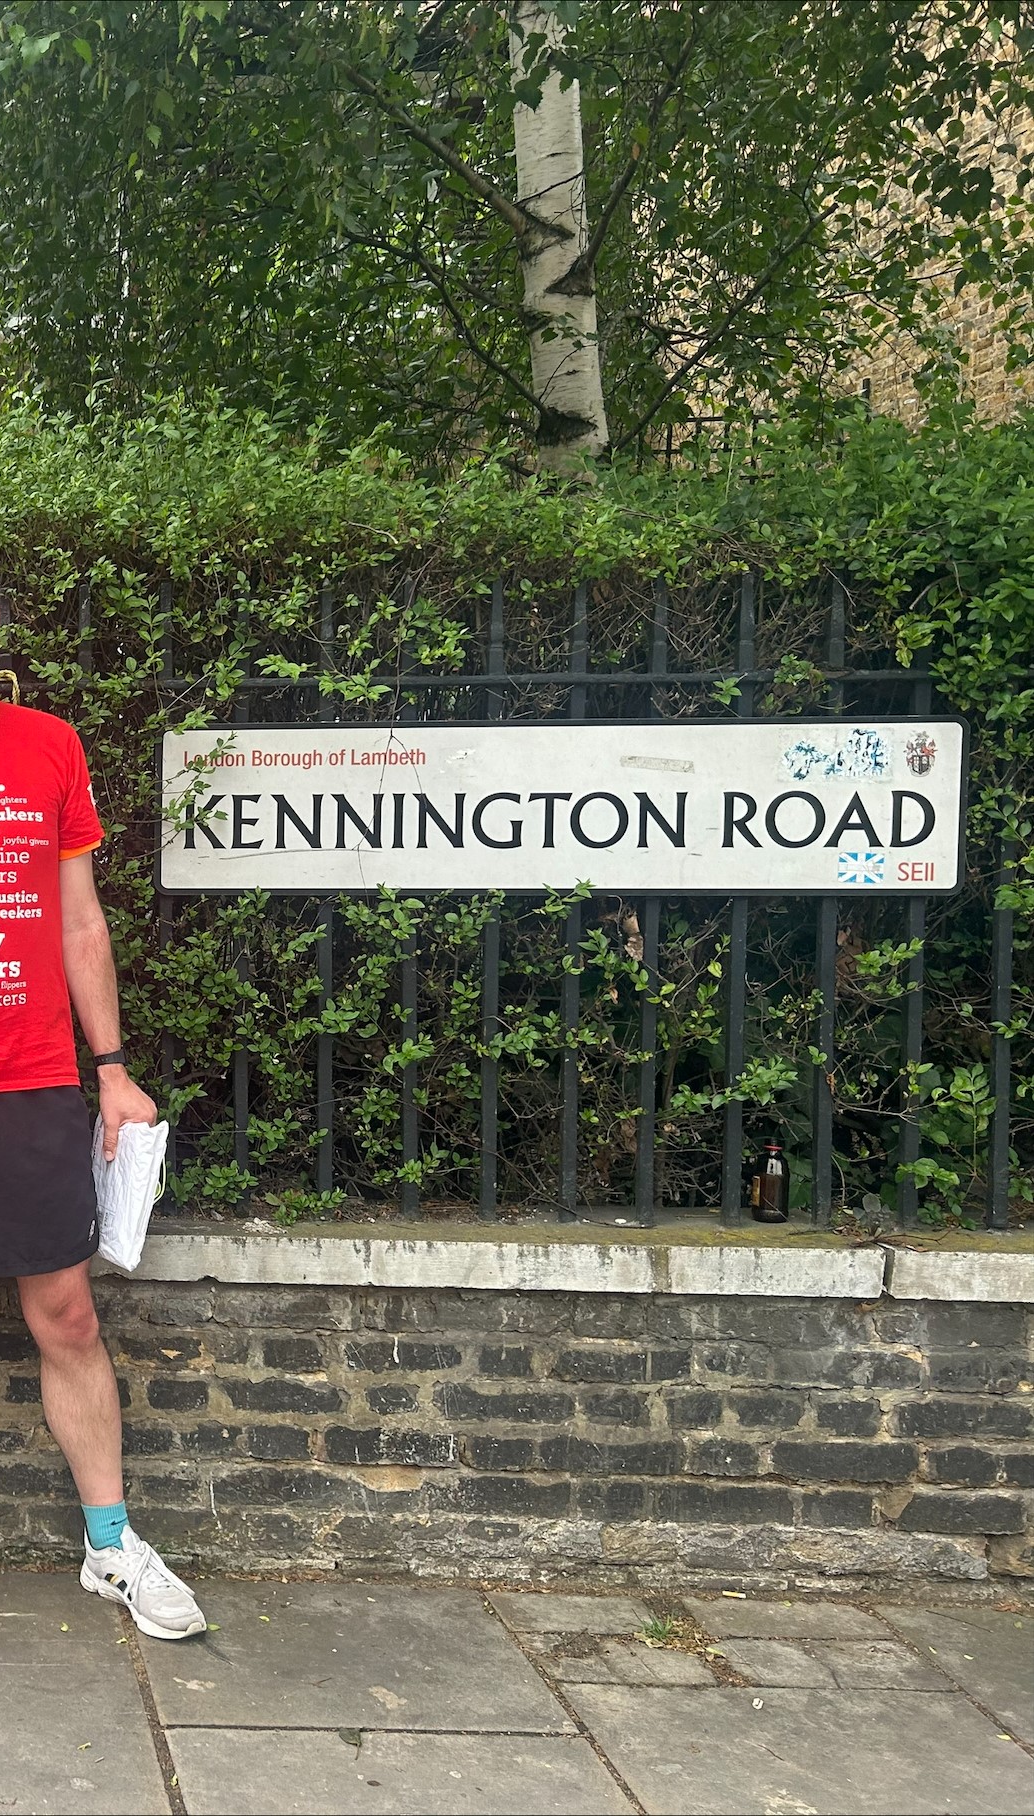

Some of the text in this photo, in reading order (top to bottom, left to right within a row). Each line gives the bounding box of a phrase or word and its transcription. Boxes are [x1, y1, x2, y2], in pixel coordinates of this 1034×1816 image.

[252, 749, 323, 769] Borough
[329, 749, 346, 765] of
[351, 748, 426, 766] Lambeth
[183, 790, 936, 850] KENNINGTON ROAD
[2, 836, 28, 847] joyful
[0, 980, 27, 990] flippers
